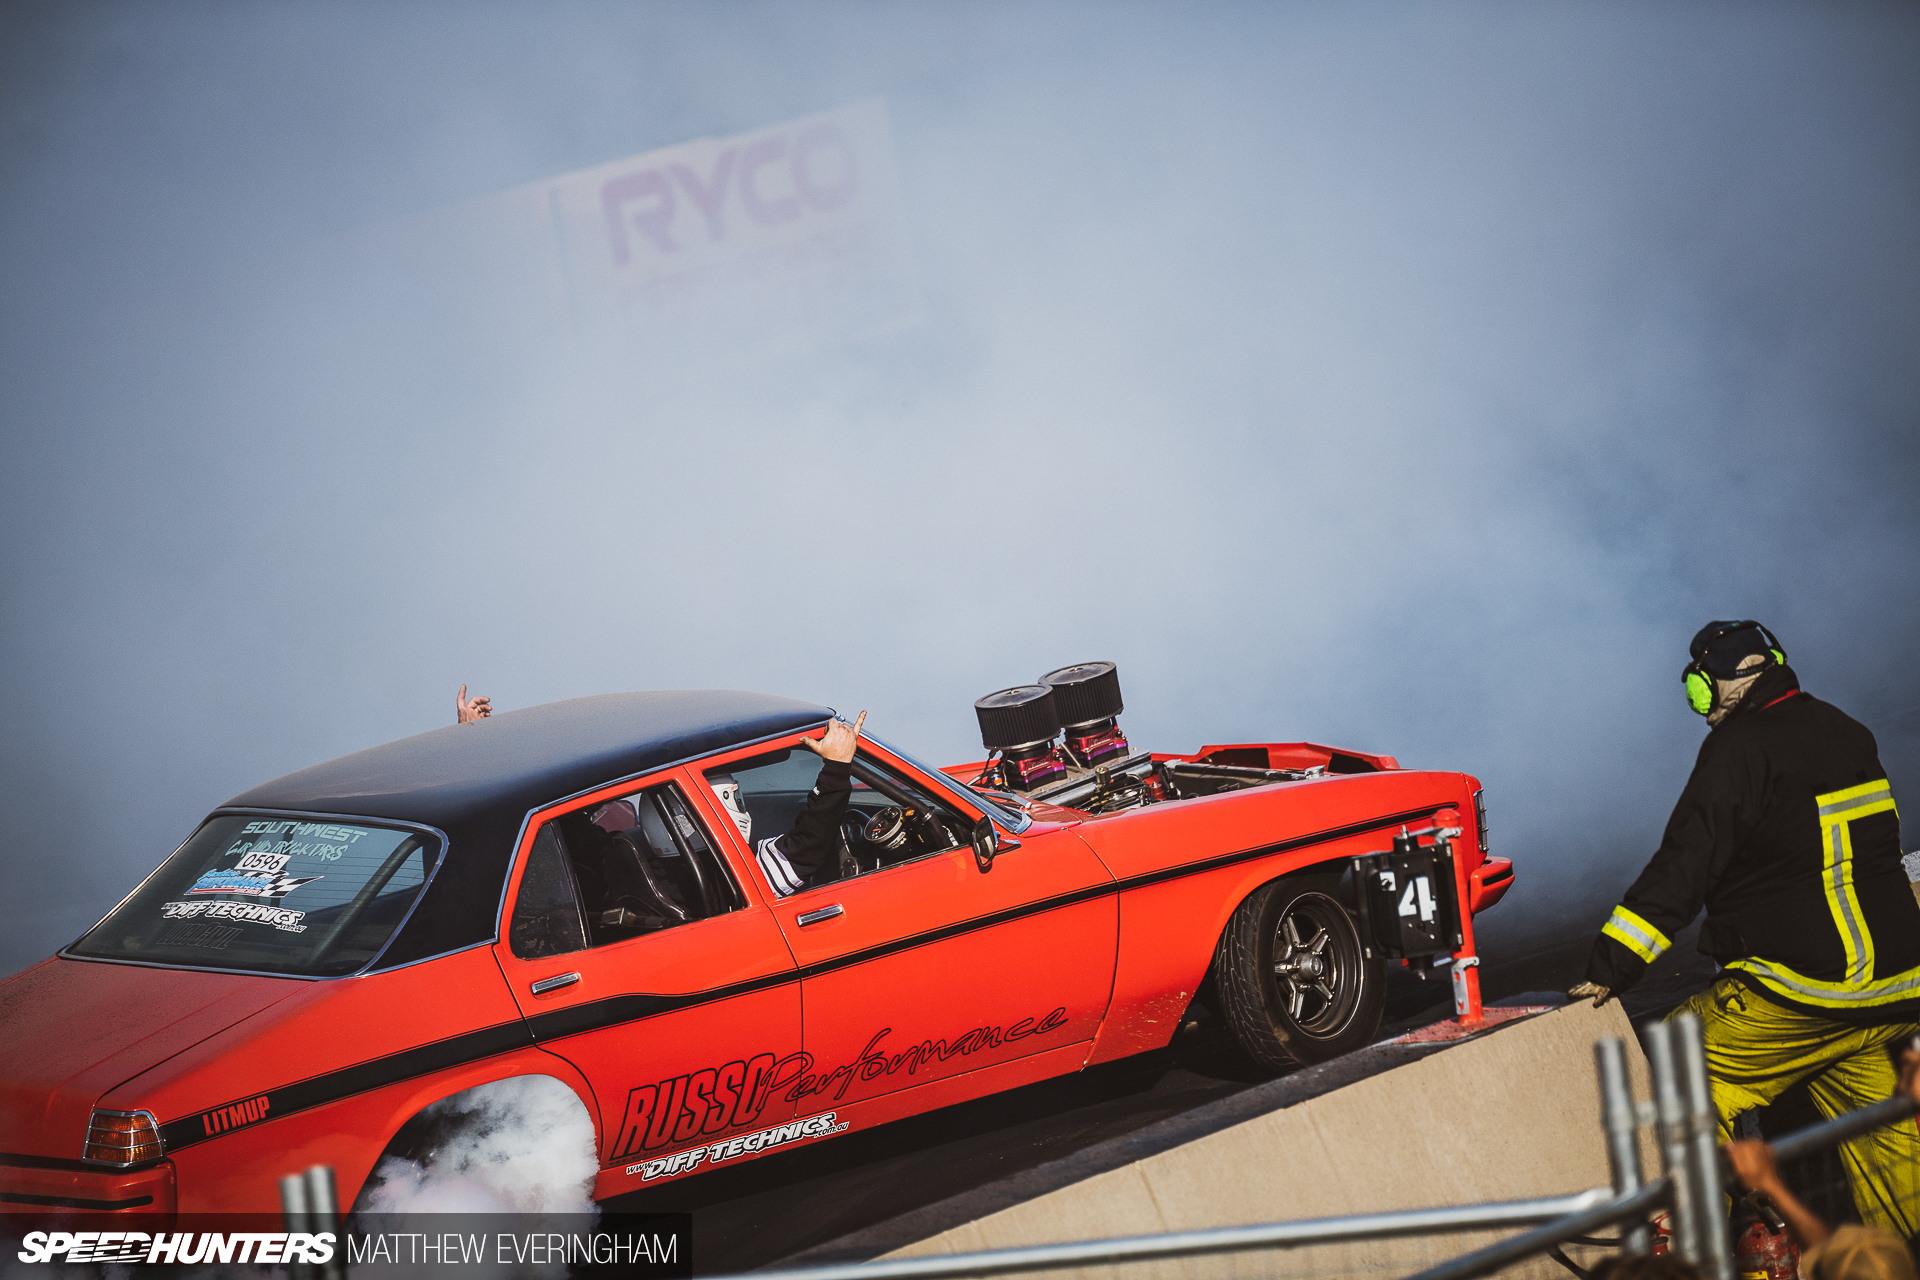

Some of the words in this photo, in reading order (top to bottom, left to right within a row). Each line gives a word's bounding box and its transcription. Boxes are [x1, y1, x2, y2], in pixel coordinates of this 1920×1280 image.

[600, 120, 861, 270] RYCO
[241, 821, 368, 843] SOUTHWEST
[242, 853, 282, 870] 0596
[163, 900, 213, 919] DIFF
[205, 901, 305, 925] TECHNICS
[609, 1053, 775, 1162] RUSSO
[755, 1006, 1069, 1112] Performance
[202, 1095, 270, 1136] LITMUP
[642, 1147, 709, 1181] DIFF
[709, 1112, 836, 1162] TECHNICS
